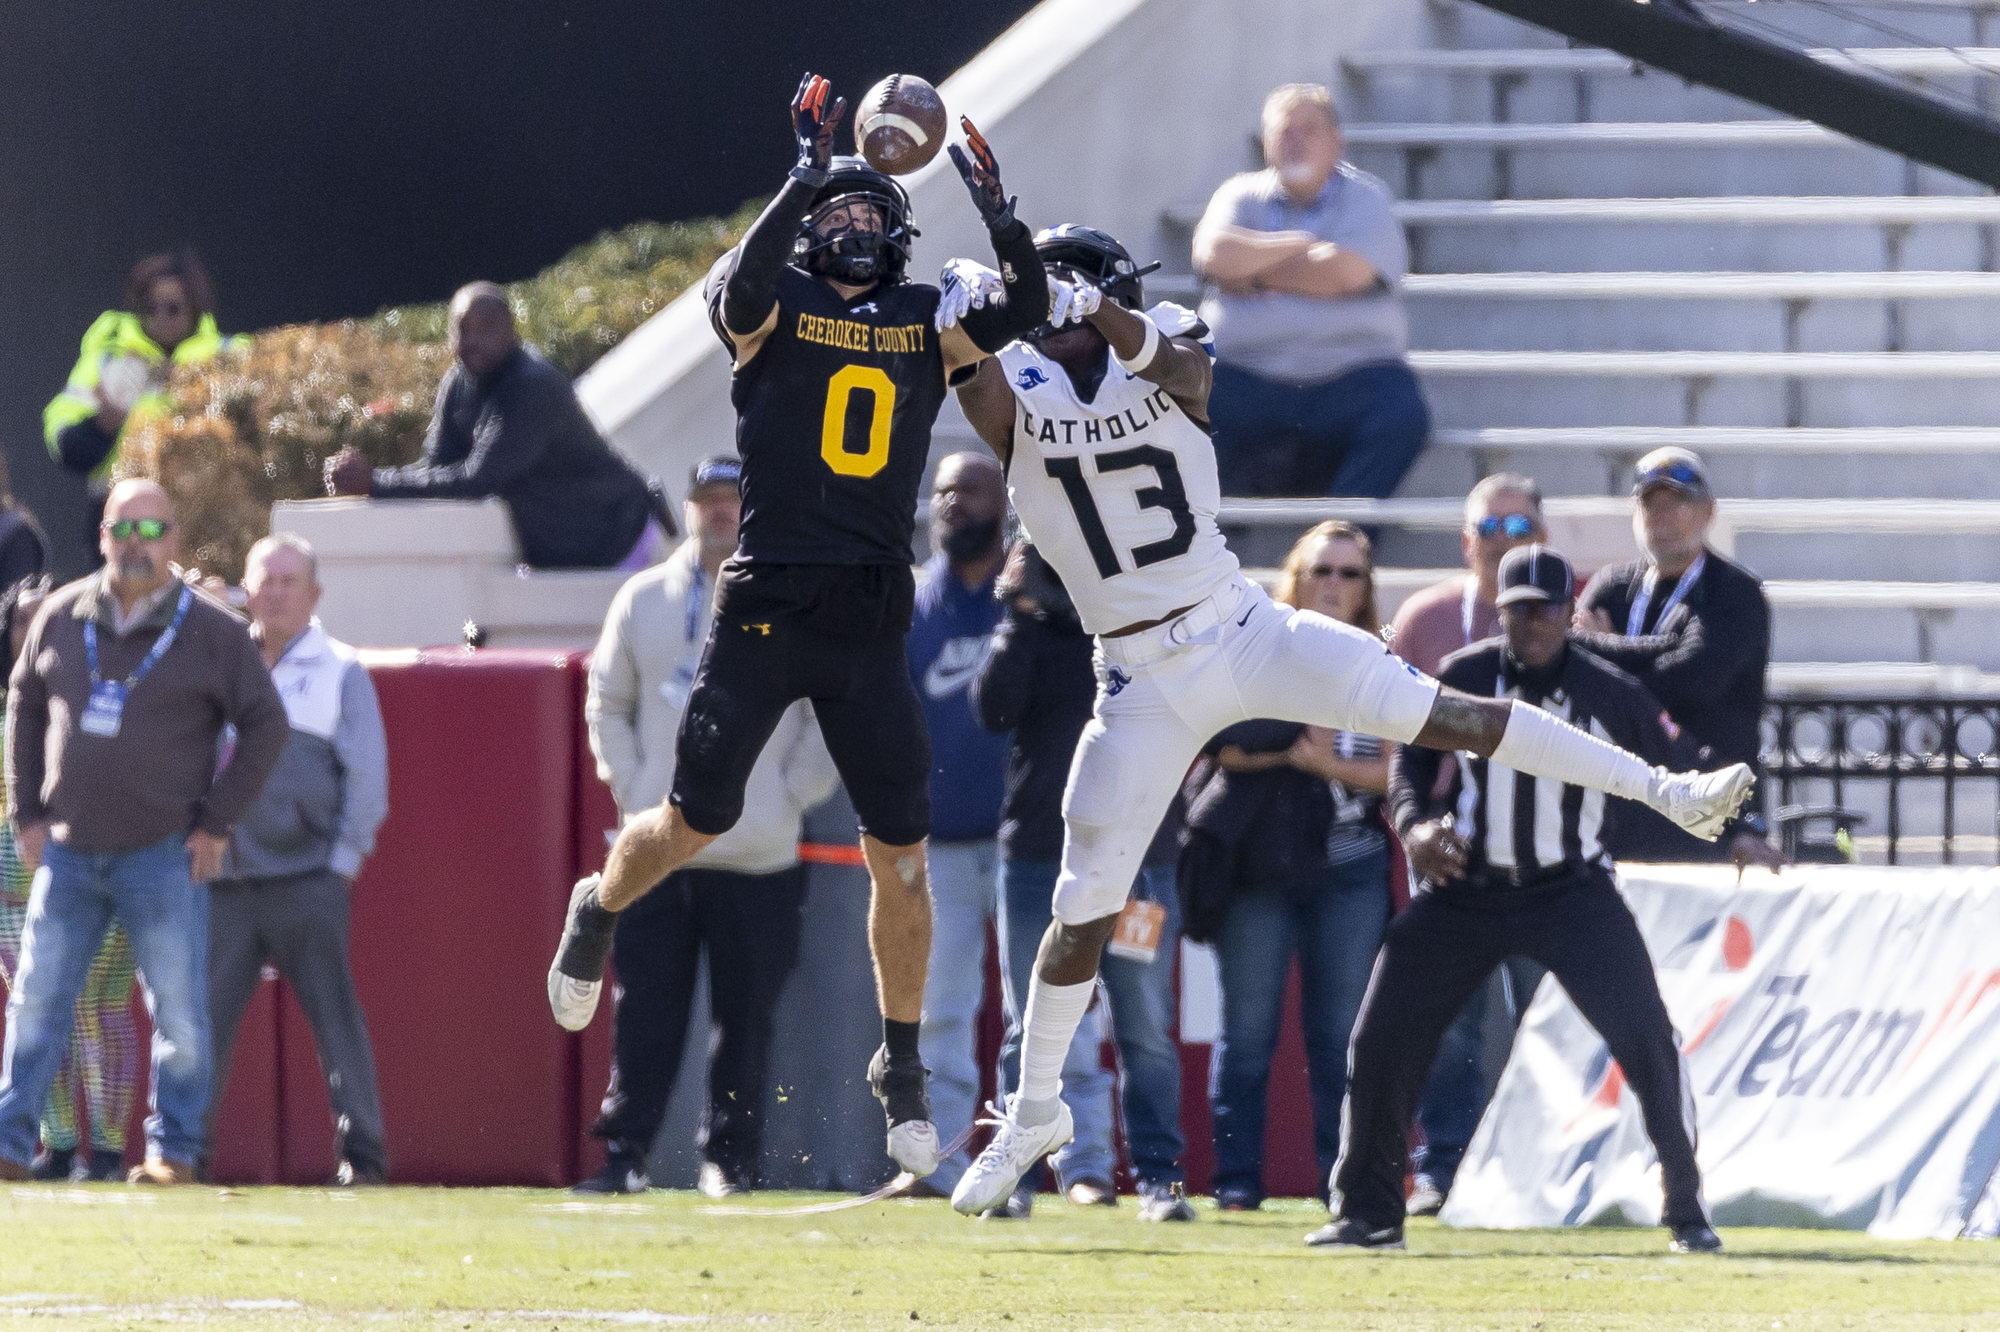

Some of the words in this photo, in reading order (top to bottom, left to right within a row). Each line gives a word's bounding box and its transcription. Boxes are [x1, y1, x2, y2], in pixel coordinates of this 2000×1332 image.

[796, 312, 870, 352] CHEROKEE
[874, 323, 925, 353] COUNTY
[820, 364, 896, 479] 0
[1024, 388, 1170, 444] CATHOLIC
[1044, 443, 1197, 580] 13
